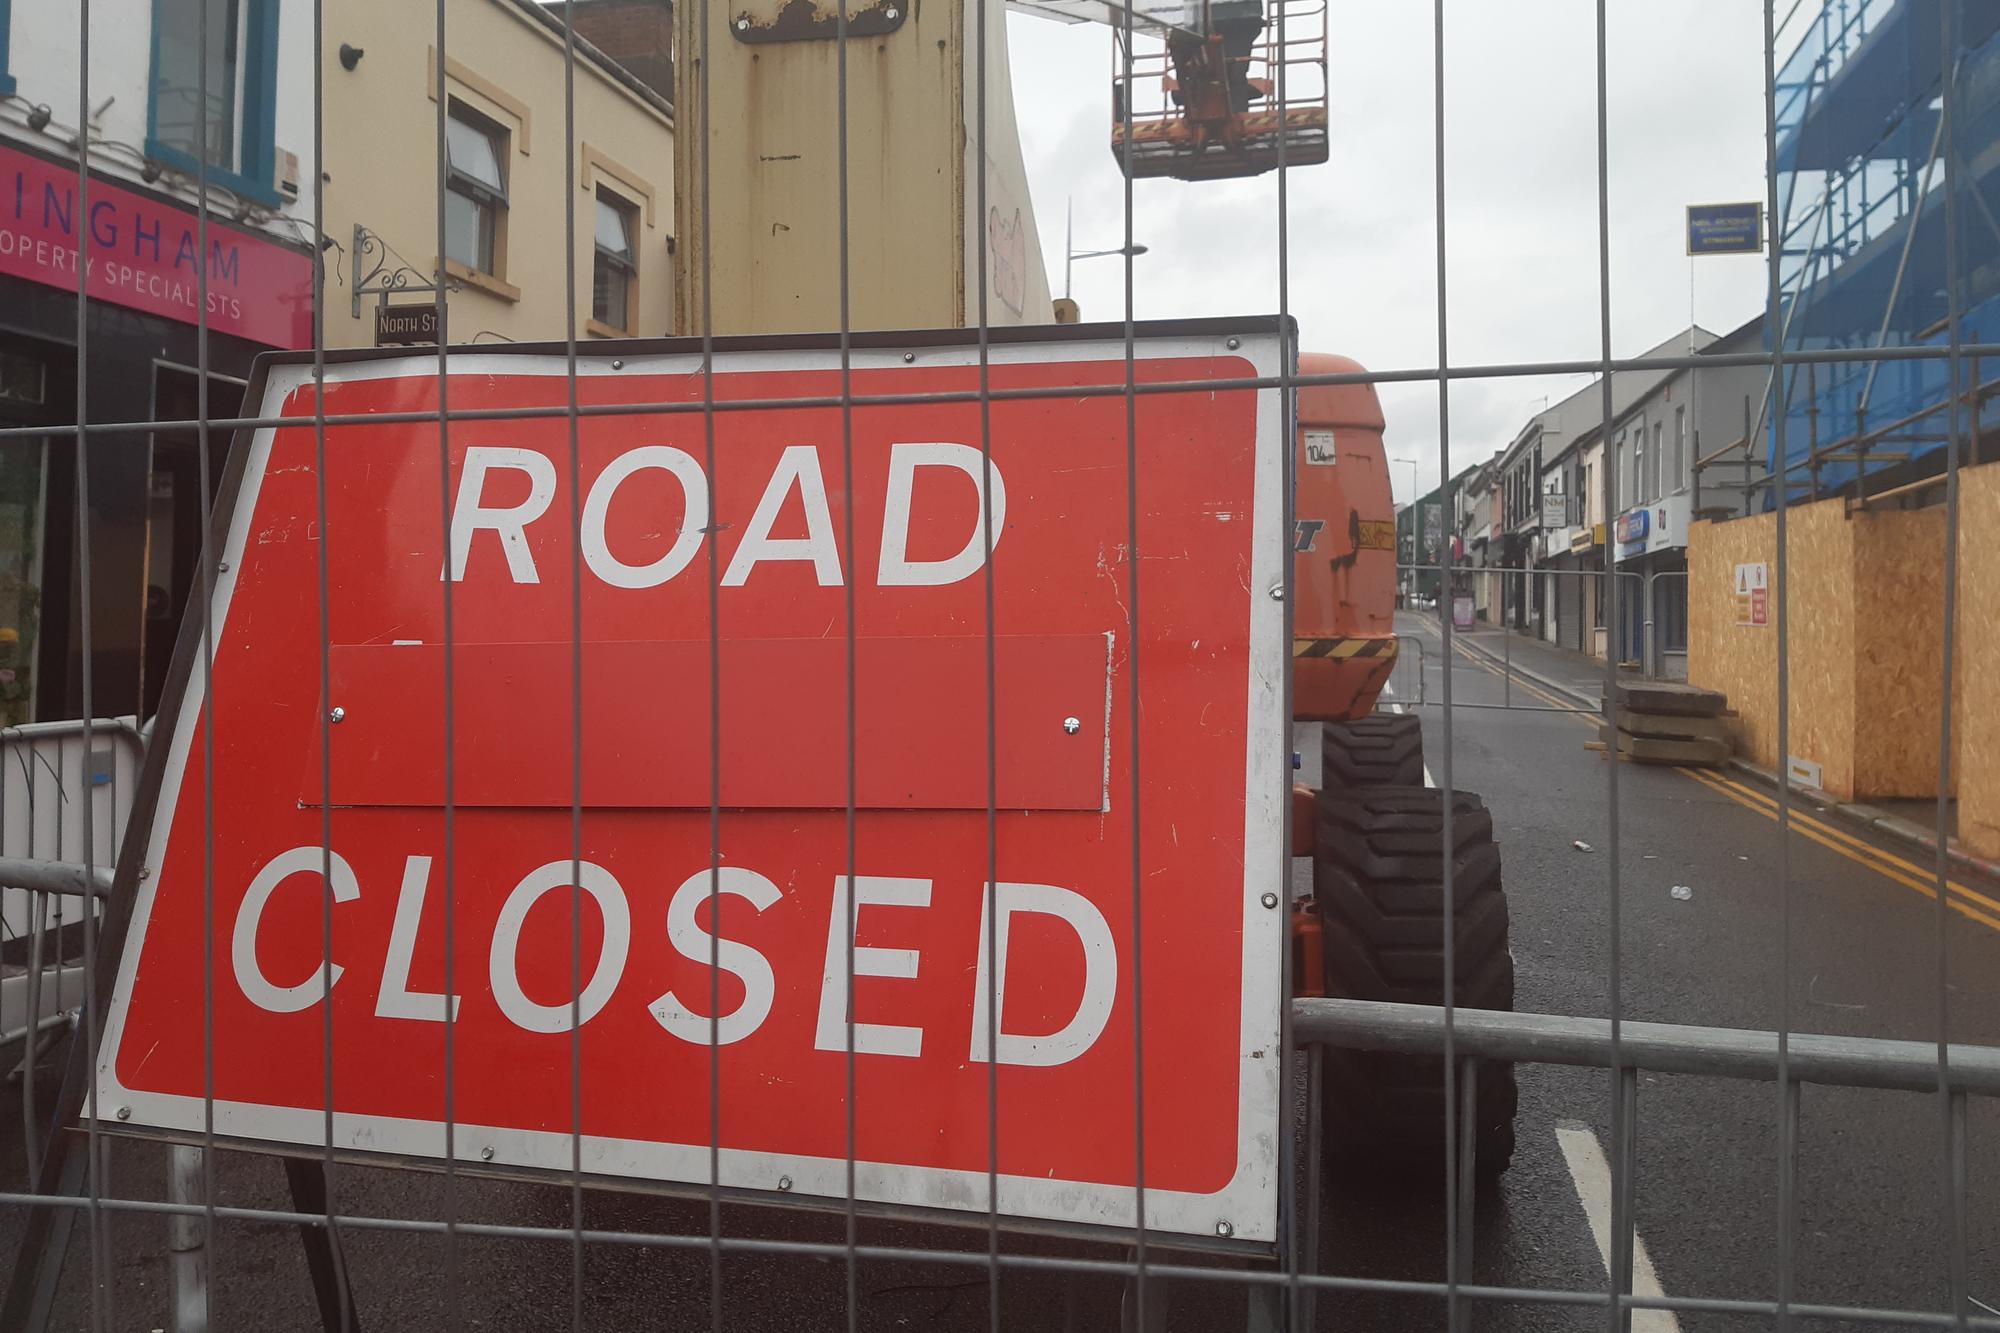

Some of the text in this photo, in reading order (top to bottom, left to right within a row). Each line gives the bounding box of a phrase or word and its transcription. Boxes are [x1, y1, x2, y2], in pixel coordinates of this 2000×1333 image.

[15, 171, 239, 289] INGHAM
[104, 260, 241, 320] SPECIALSTS
[380, 315, 417, 334] NORTH
[440, 442, 1007, 589] ROAD
[231, 846, 1119, 1067] CLOSED
